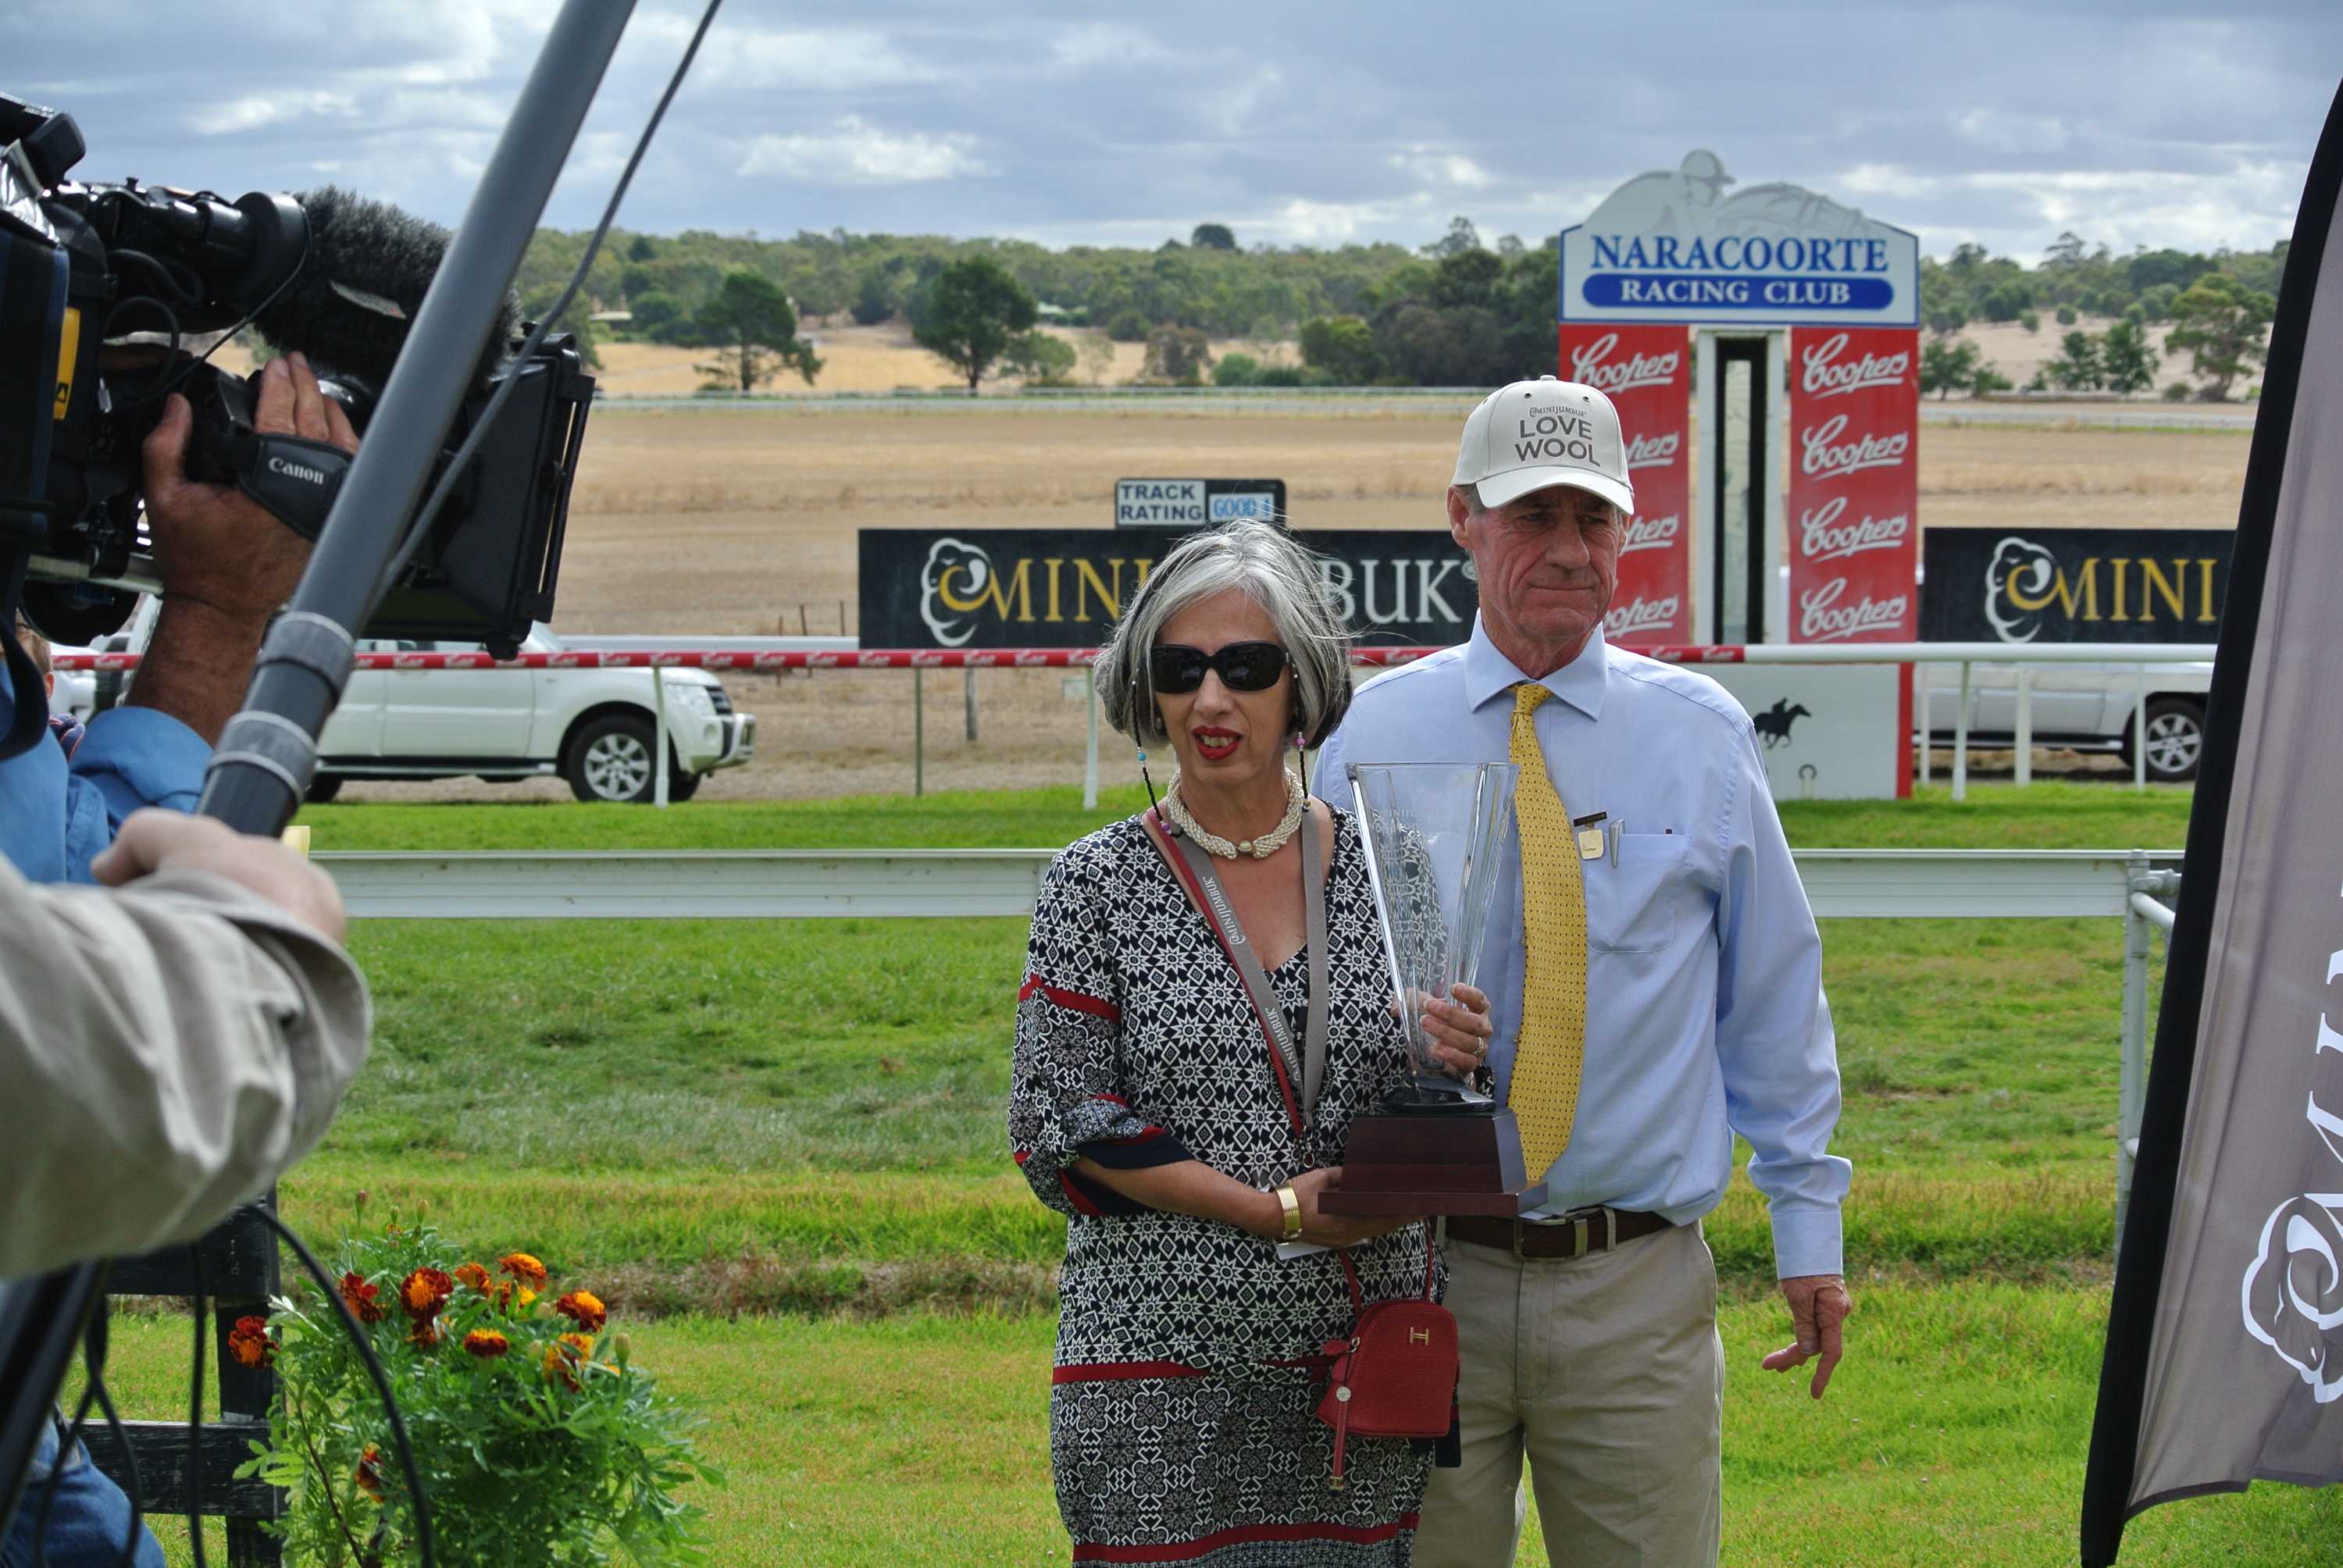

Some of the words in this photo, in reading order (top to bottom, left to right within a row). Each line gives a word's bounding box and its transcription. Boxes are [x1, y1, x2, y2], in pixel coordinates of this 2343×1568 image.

[1590, 235, 1889, 272] NARACOORTE
[1621, 279, 1750, 303] RACING
[1763, 281, 1852, 305] CLUB
[1571, 333, 1680, 393] Coopers
[1802, 333, 1909, 399] Coopers
[1519, 415, 1593, 440] LOVE
[1802, 415, 1909, 480] Coopers
[269, 457, 324, 485] Canon
[1514, 437, 1601, 467] WOOL
[1120, 505, 1202, 520] RATING
[1121, 484, 1195, 500] TRACK
[1800, 497, 1908, 563] Coopers
[1799, 578, 1908, 643] Coopers
[2006, 557, 2219, 622] MINI
[1603, 594, 1680, 637] opers
[1203, 877, 1243, 942] MINIJUMBUK
